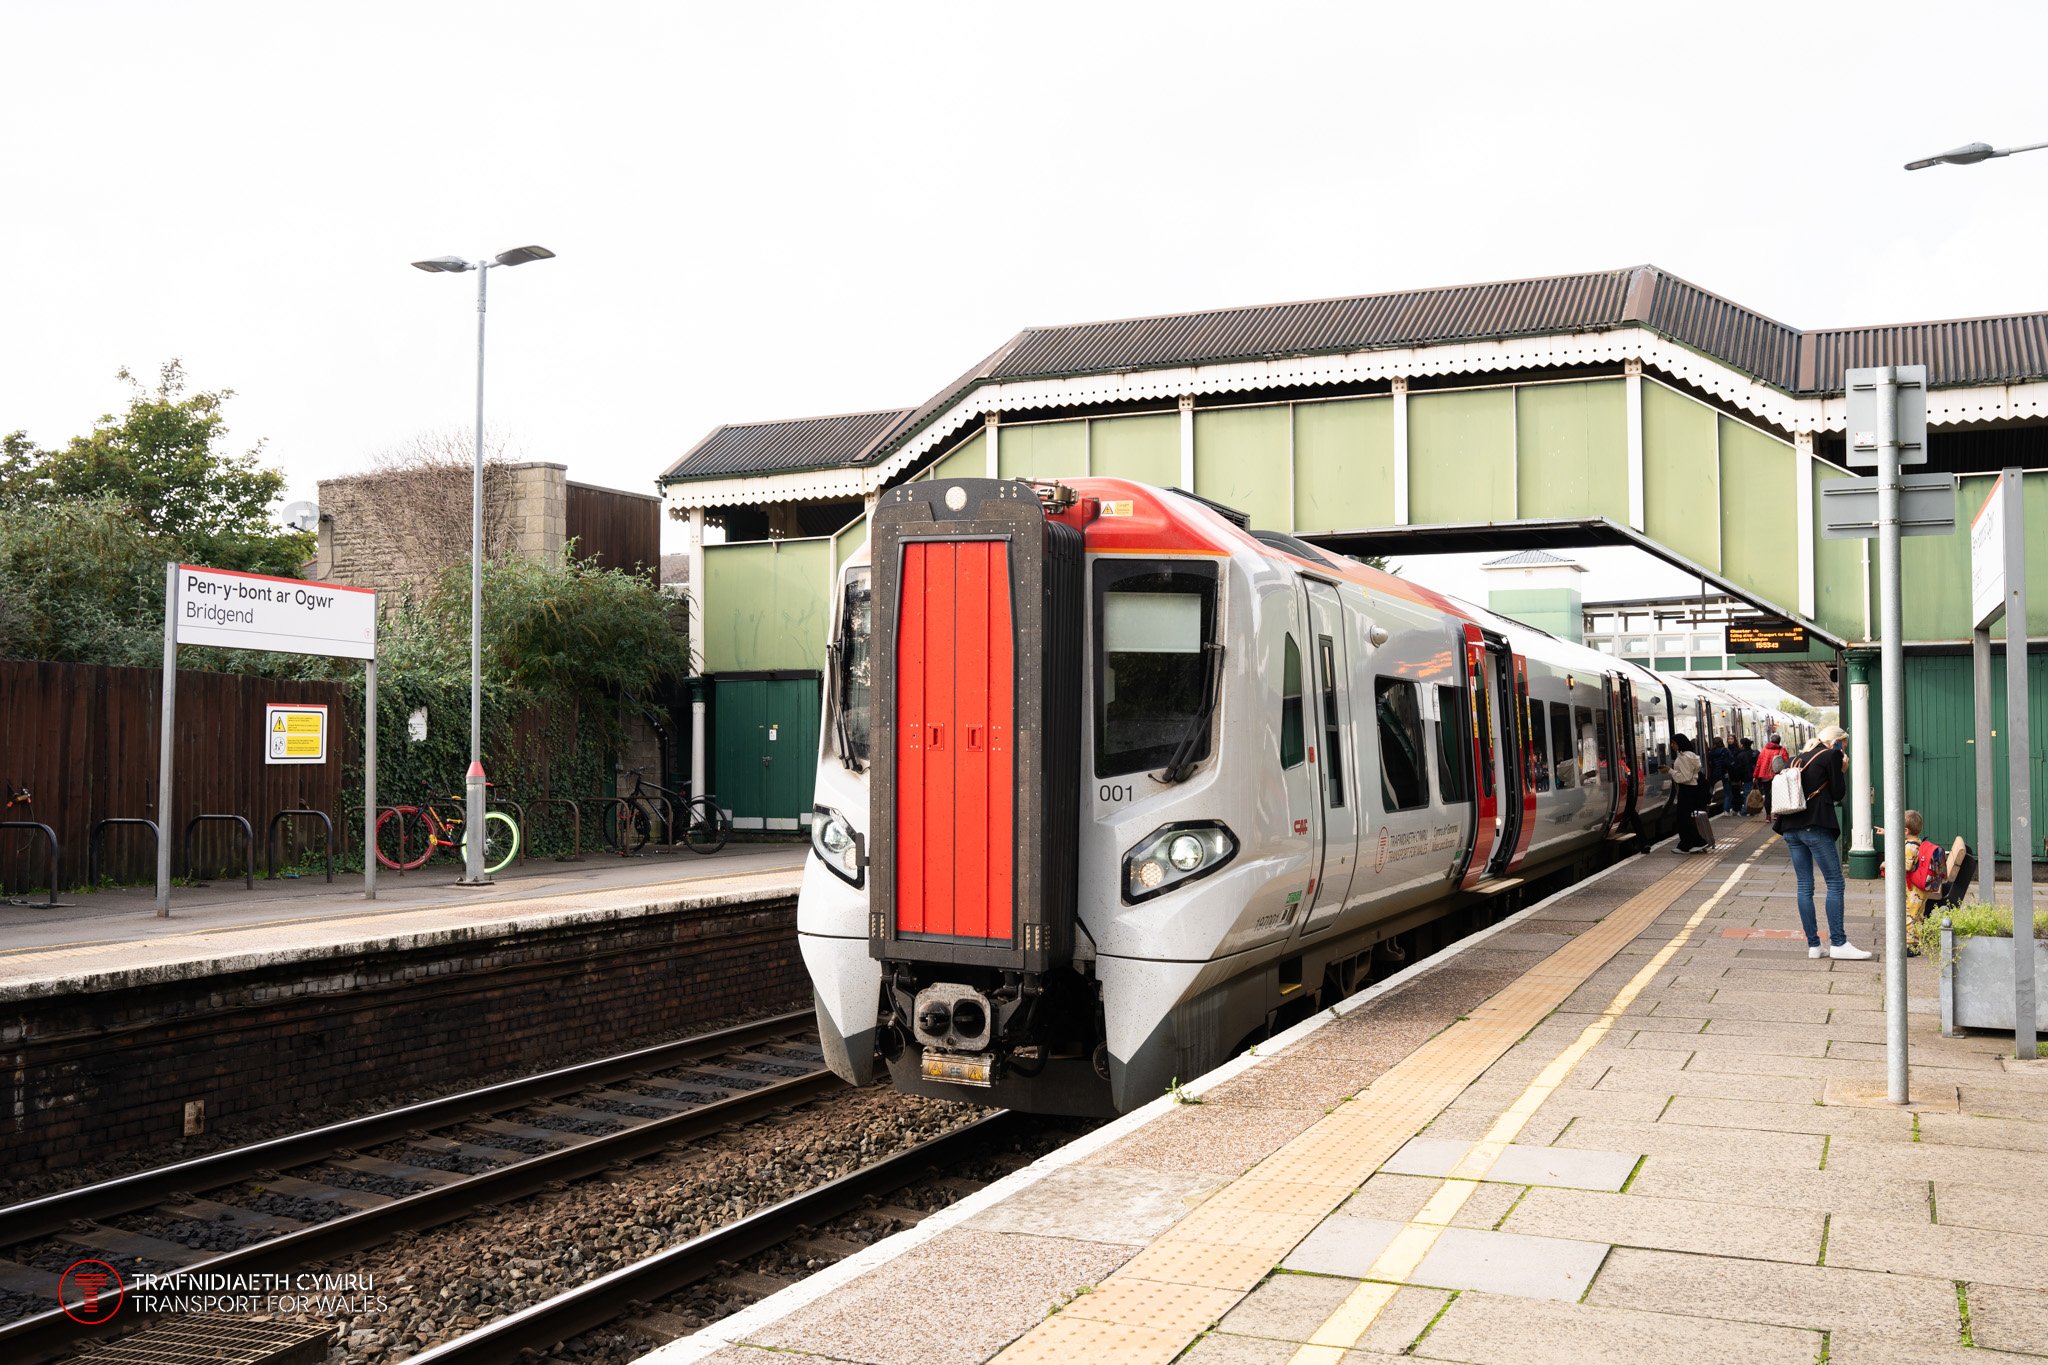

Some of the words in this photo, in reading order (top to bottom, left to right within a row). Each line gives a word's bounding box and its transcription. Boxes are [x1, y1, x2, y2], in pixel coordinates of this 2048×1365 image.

[187, 576, 272, 601] Pen-y-bont
[276, 590, 290, 603] ar
[295, 590, 334, 610] Ogwr
[186, 601, 254, 625] Bridgend
[1100, 785, 1132, 801] 001
